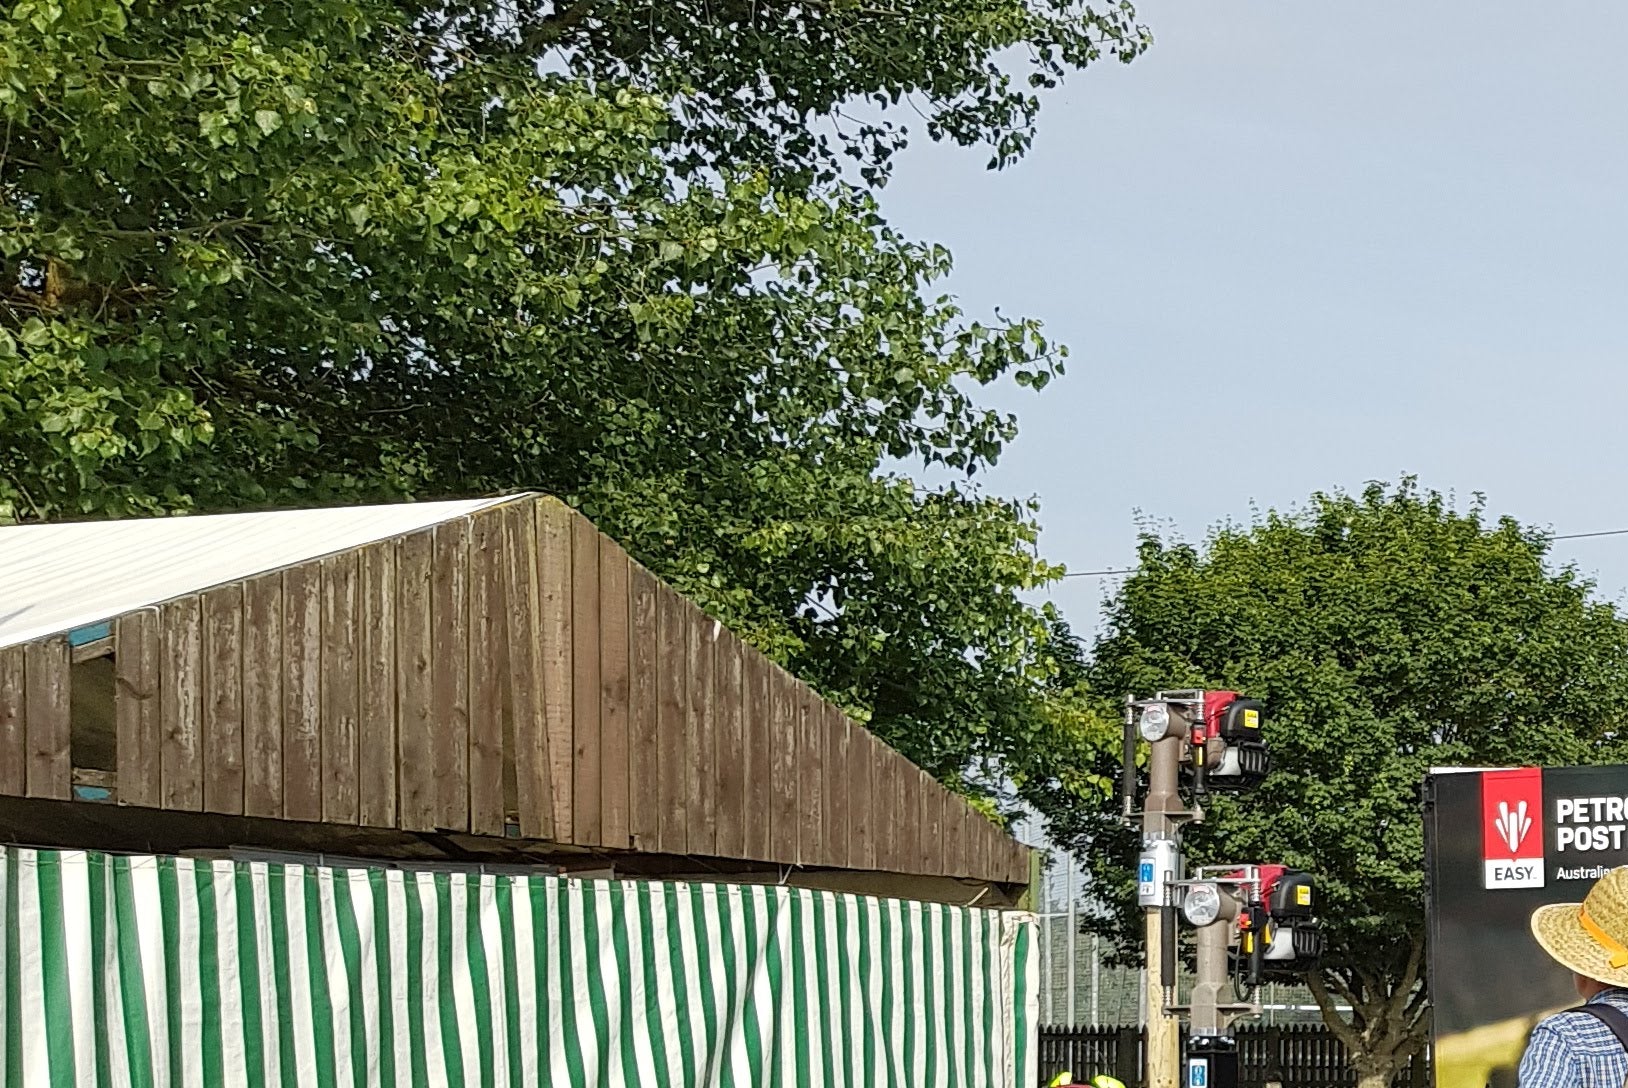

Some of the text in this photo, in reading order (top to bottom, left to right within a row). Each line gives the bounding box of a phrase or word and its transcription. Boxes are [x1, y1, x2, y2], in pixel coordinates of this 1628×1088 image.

[1557, 825, 1626, 851] POST
[1494, 867, 1534, 881] EASY
[1556, 866, 1616, 880] Australia
